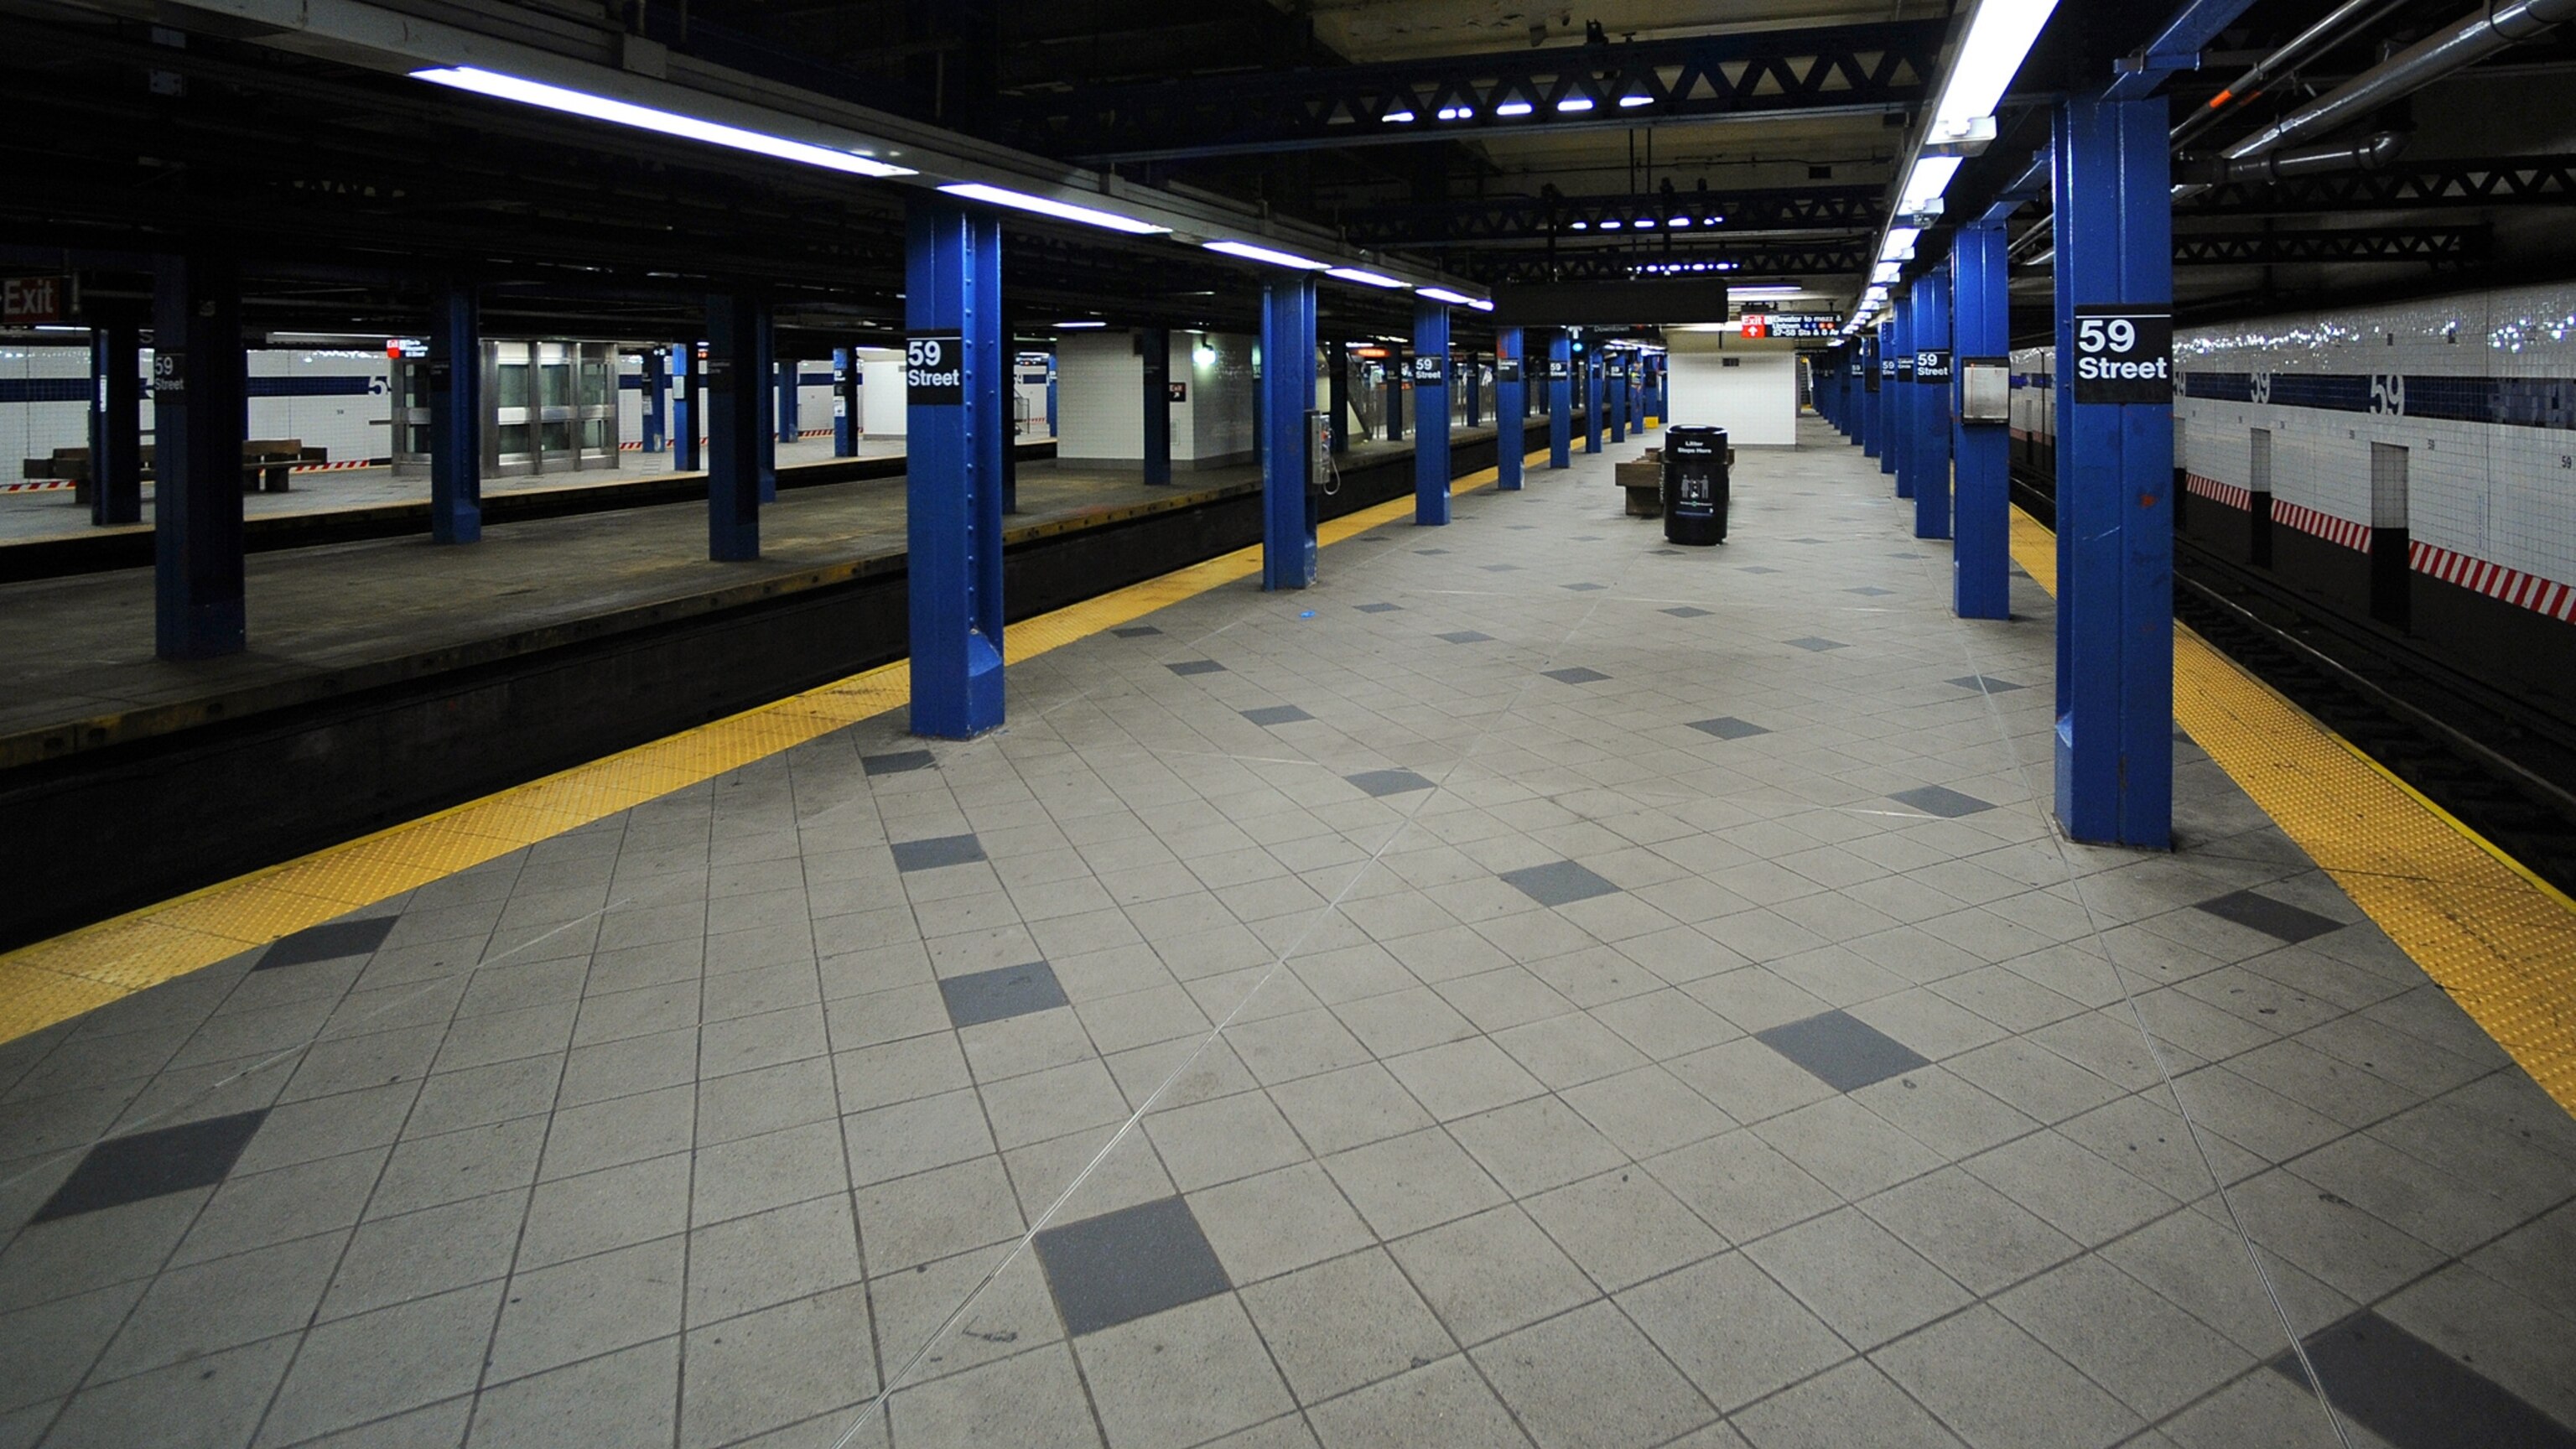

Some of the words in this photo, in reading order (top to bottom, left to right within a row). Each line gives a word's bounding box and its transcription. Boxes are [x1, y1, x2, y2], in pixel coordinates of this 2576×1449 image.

[3, 279, 55, 314] Exit
[1742, 314, 1765, 325] Exit
[2079, 319, 2136, 353] 59
[908, 340, 942, 366] 59
[1918, 354, 1938, 366] 59
[154, 356, 174, 376] 59
[1415, 358, 1432, 371] 59
[1883, 361, 1895, 370] 59
[1918, 366, 1949, 377] Street
[2078, 356, 2168, 380] Street
[908, 368, 960, 387] Street
[1415, 371, 1441, 379] Street
[154, 377, 184, 391] Street
[2250, 371, 2271, 404] 59
[2369, 375, 2405, 416] 59
[2562, 455, 2572, 469] 59
